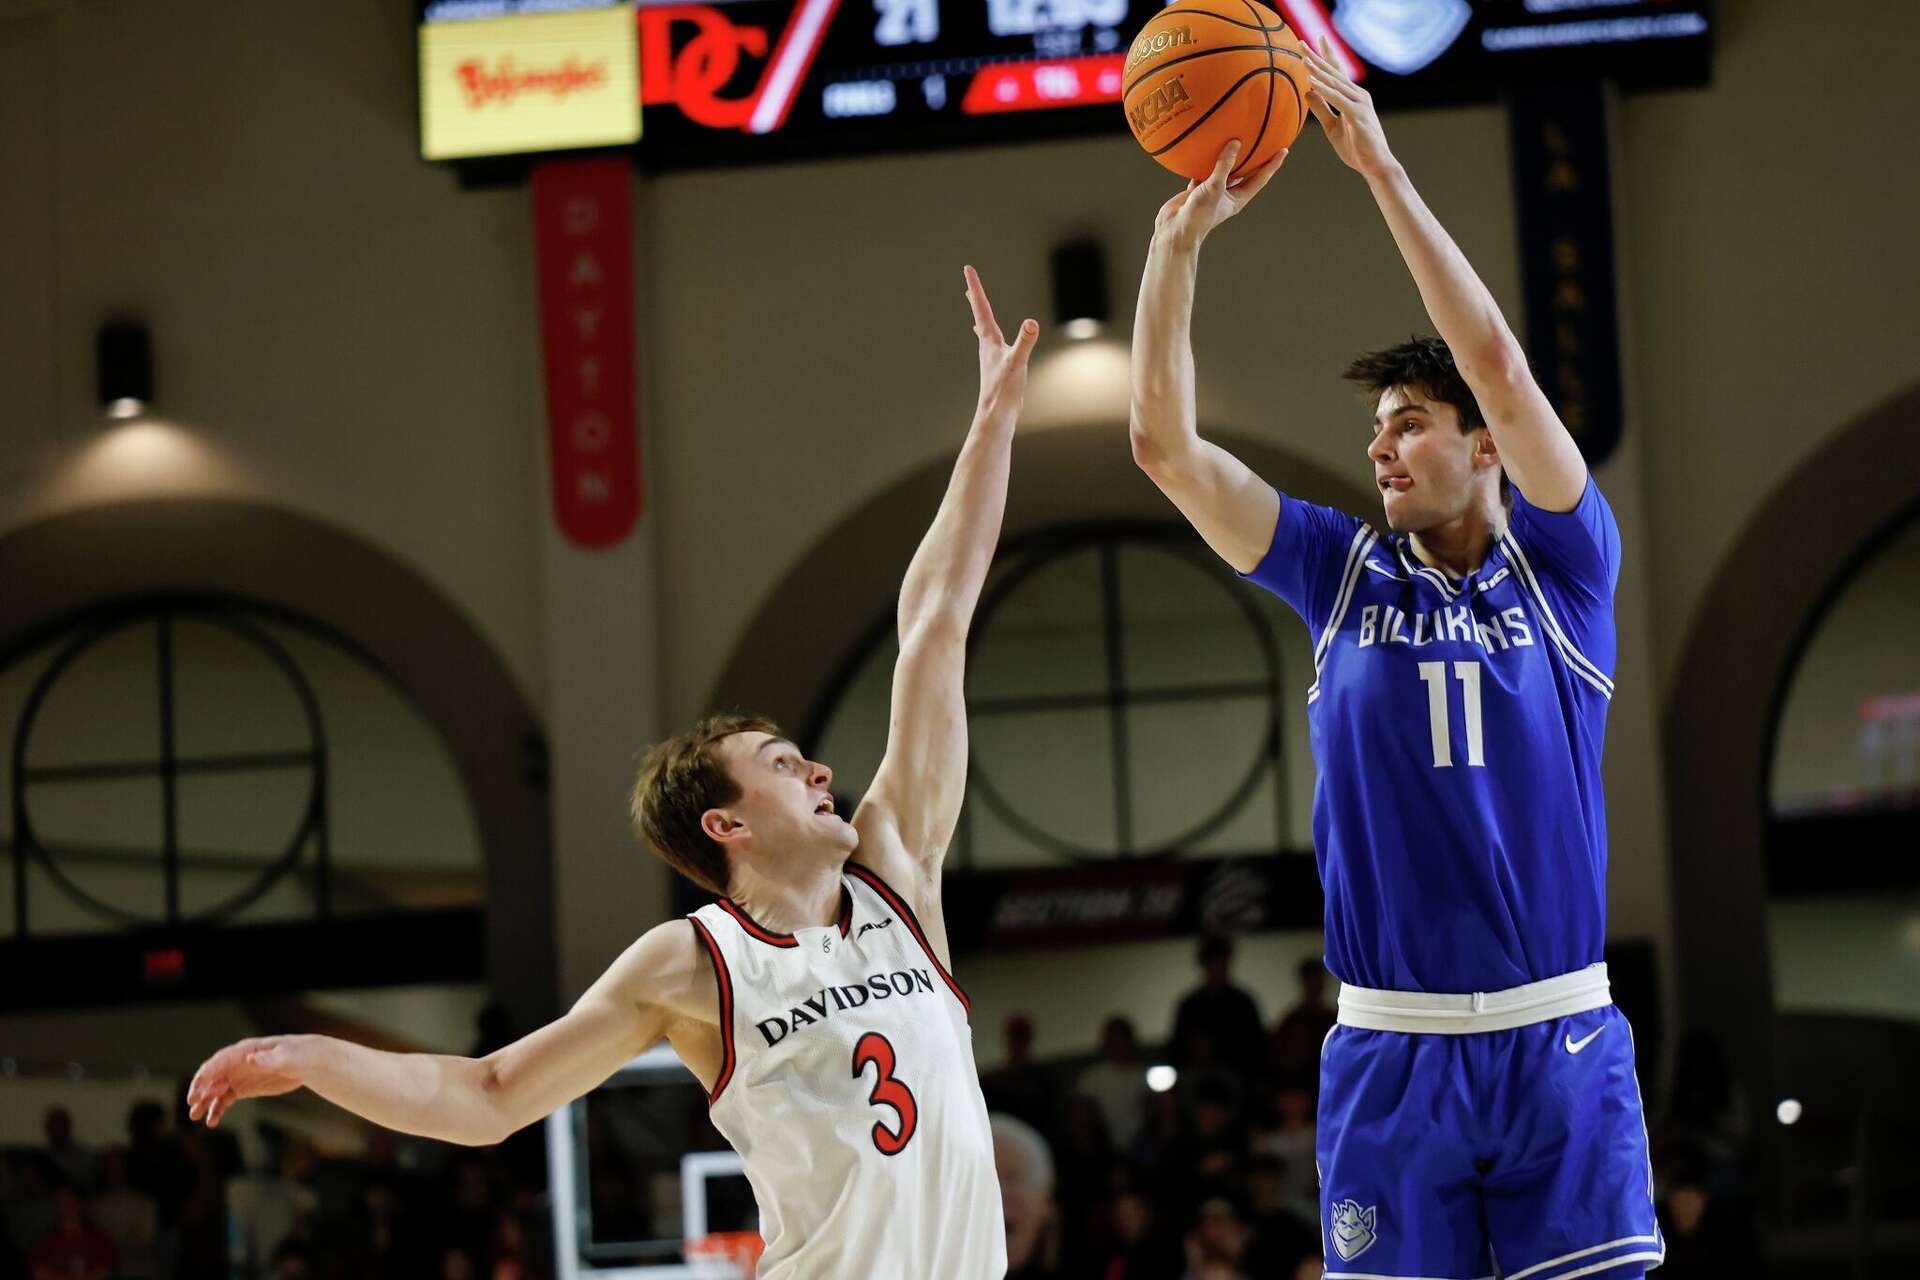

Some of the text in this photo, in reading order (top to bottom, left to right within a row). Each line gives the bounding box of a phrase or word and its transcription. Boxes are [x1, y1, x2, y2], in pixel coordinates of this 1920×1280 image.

[1129, 78, 1191, 134] NCAA
[1358, 603, 1534, 655] BILLIKNS
[1417, 660, 1486, 768] 11
[755, 967, 935, 1048] DAVIDSON
[852, 1031, 918, 1157] 3
